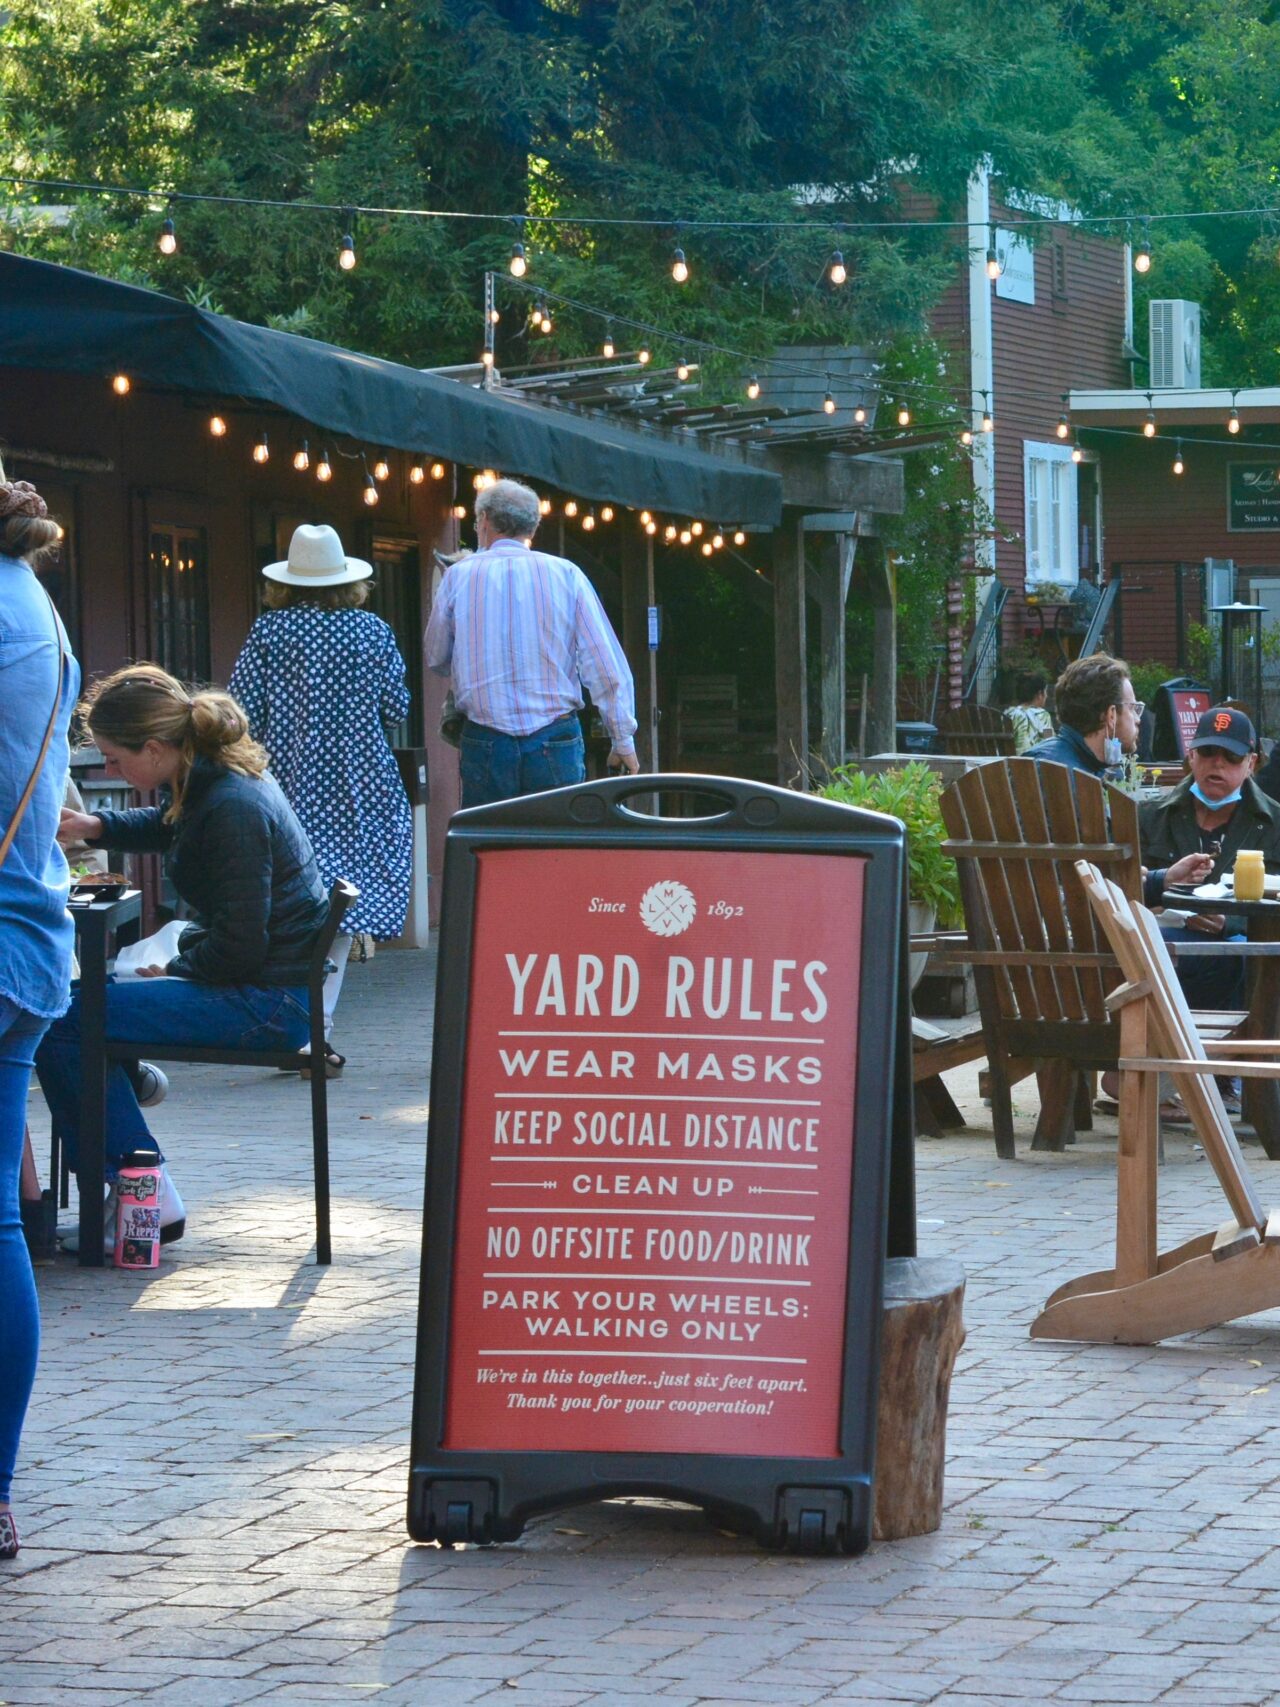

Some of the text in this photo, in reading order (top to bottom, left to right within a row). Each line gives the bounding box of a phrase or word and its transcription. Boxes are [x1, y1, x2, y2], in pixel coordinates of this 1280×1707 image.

[1244, 514, 1271, 522] STUDIO
[588, 897, 626, 913] Since
[664, 889, 673, 898] M
[649, 904, 656, 913] L
[679, 904, 688, 913] Y
[707, 900, 744, 920] 1892
[663, 919, 672, 928] V
[505, 953, 828, 1023] YARD RULES
[498, 1049, 823, 1085] WEAR MASKS
[494, 1110, 820, 1153] KEEP SOCIAL DISTANCE
[572, 1174, 734, 1197] CLEAN UP
[487, 1226, 812, 1267] NO OFFSITE FOOD/DRINK
[482, 1290, 809, 1319] PARK YOUR WHEELS:
[525, 1317, 762, 1342] WALKING ONLY
[522, 1369, 537, 1384] in
[542, 1369, 573, 1384] this
[694, 1373, 719, 1388] six
[719, 1374, 753, 1392] feet
[757, 1377, 808, 1394] apart.
[507, 1393, 775, 1417] Thank you for your cooperation!
